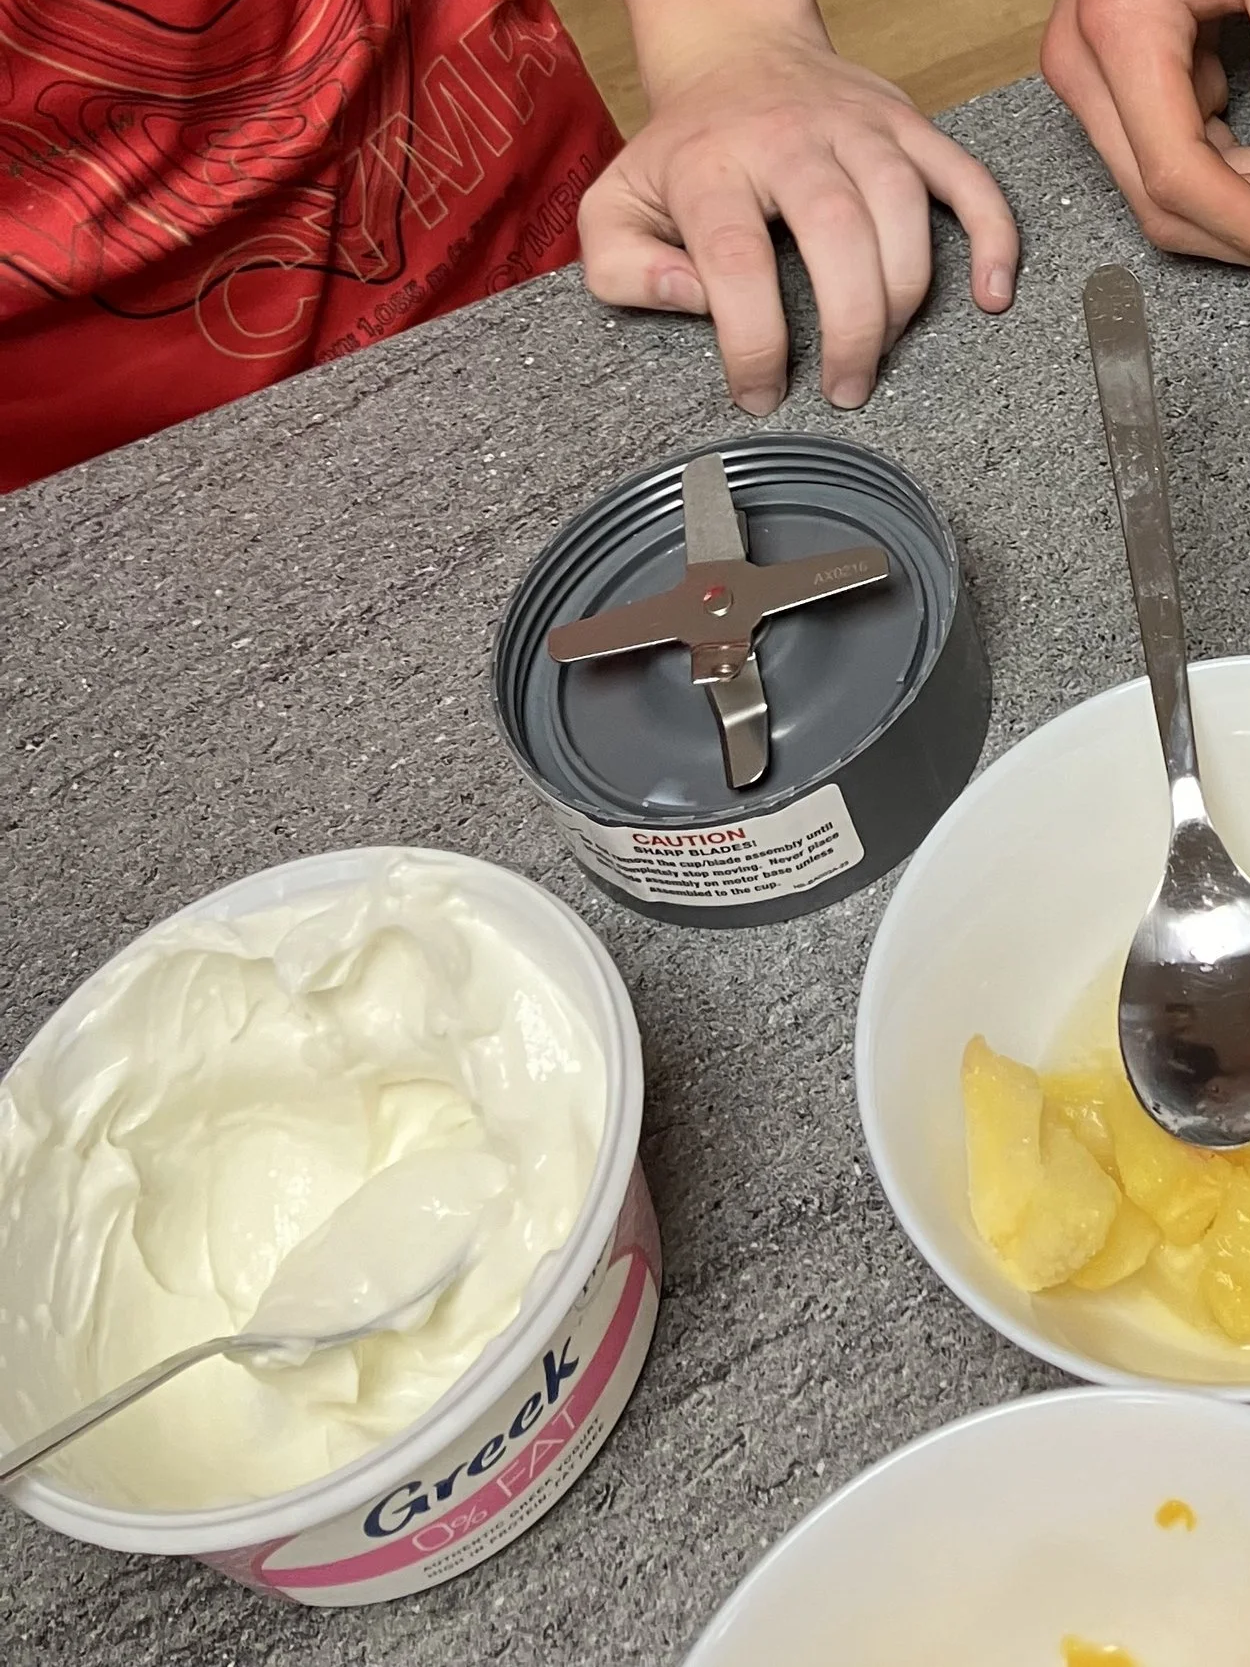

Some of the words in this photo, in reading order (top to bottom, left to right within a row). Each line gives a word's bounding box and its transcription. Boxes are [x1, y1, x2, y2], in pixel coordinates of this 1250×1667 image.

[632, 827, 747, 847] CAUTION
[633, 846, 684, 857] SHARP
[688, 840, 758, 857] BLADES!
[656, 858, 677, 868] the
[679, 855, 742, 869] cup/blade
[745, 838, 803, 861] assembly
[806, 821, 834, 841] until
[683, 869, 710, 878] stop
[768, 849, 805, 866] Never
[807, 831, 840, 854] place
[704, 879, 720, 887] on
[722, 874, 759, 886] motor
[762, 866, 793, 879] base
[795, 847, 834, 871] unless
[715, 889, 728, 897] to
[730, 887, 751, 896] the
[363, 1336, 580, 1538] Greek
[411, 1502, 488, 1552] 0%
[496, 1394, 576, 1499] FAT
